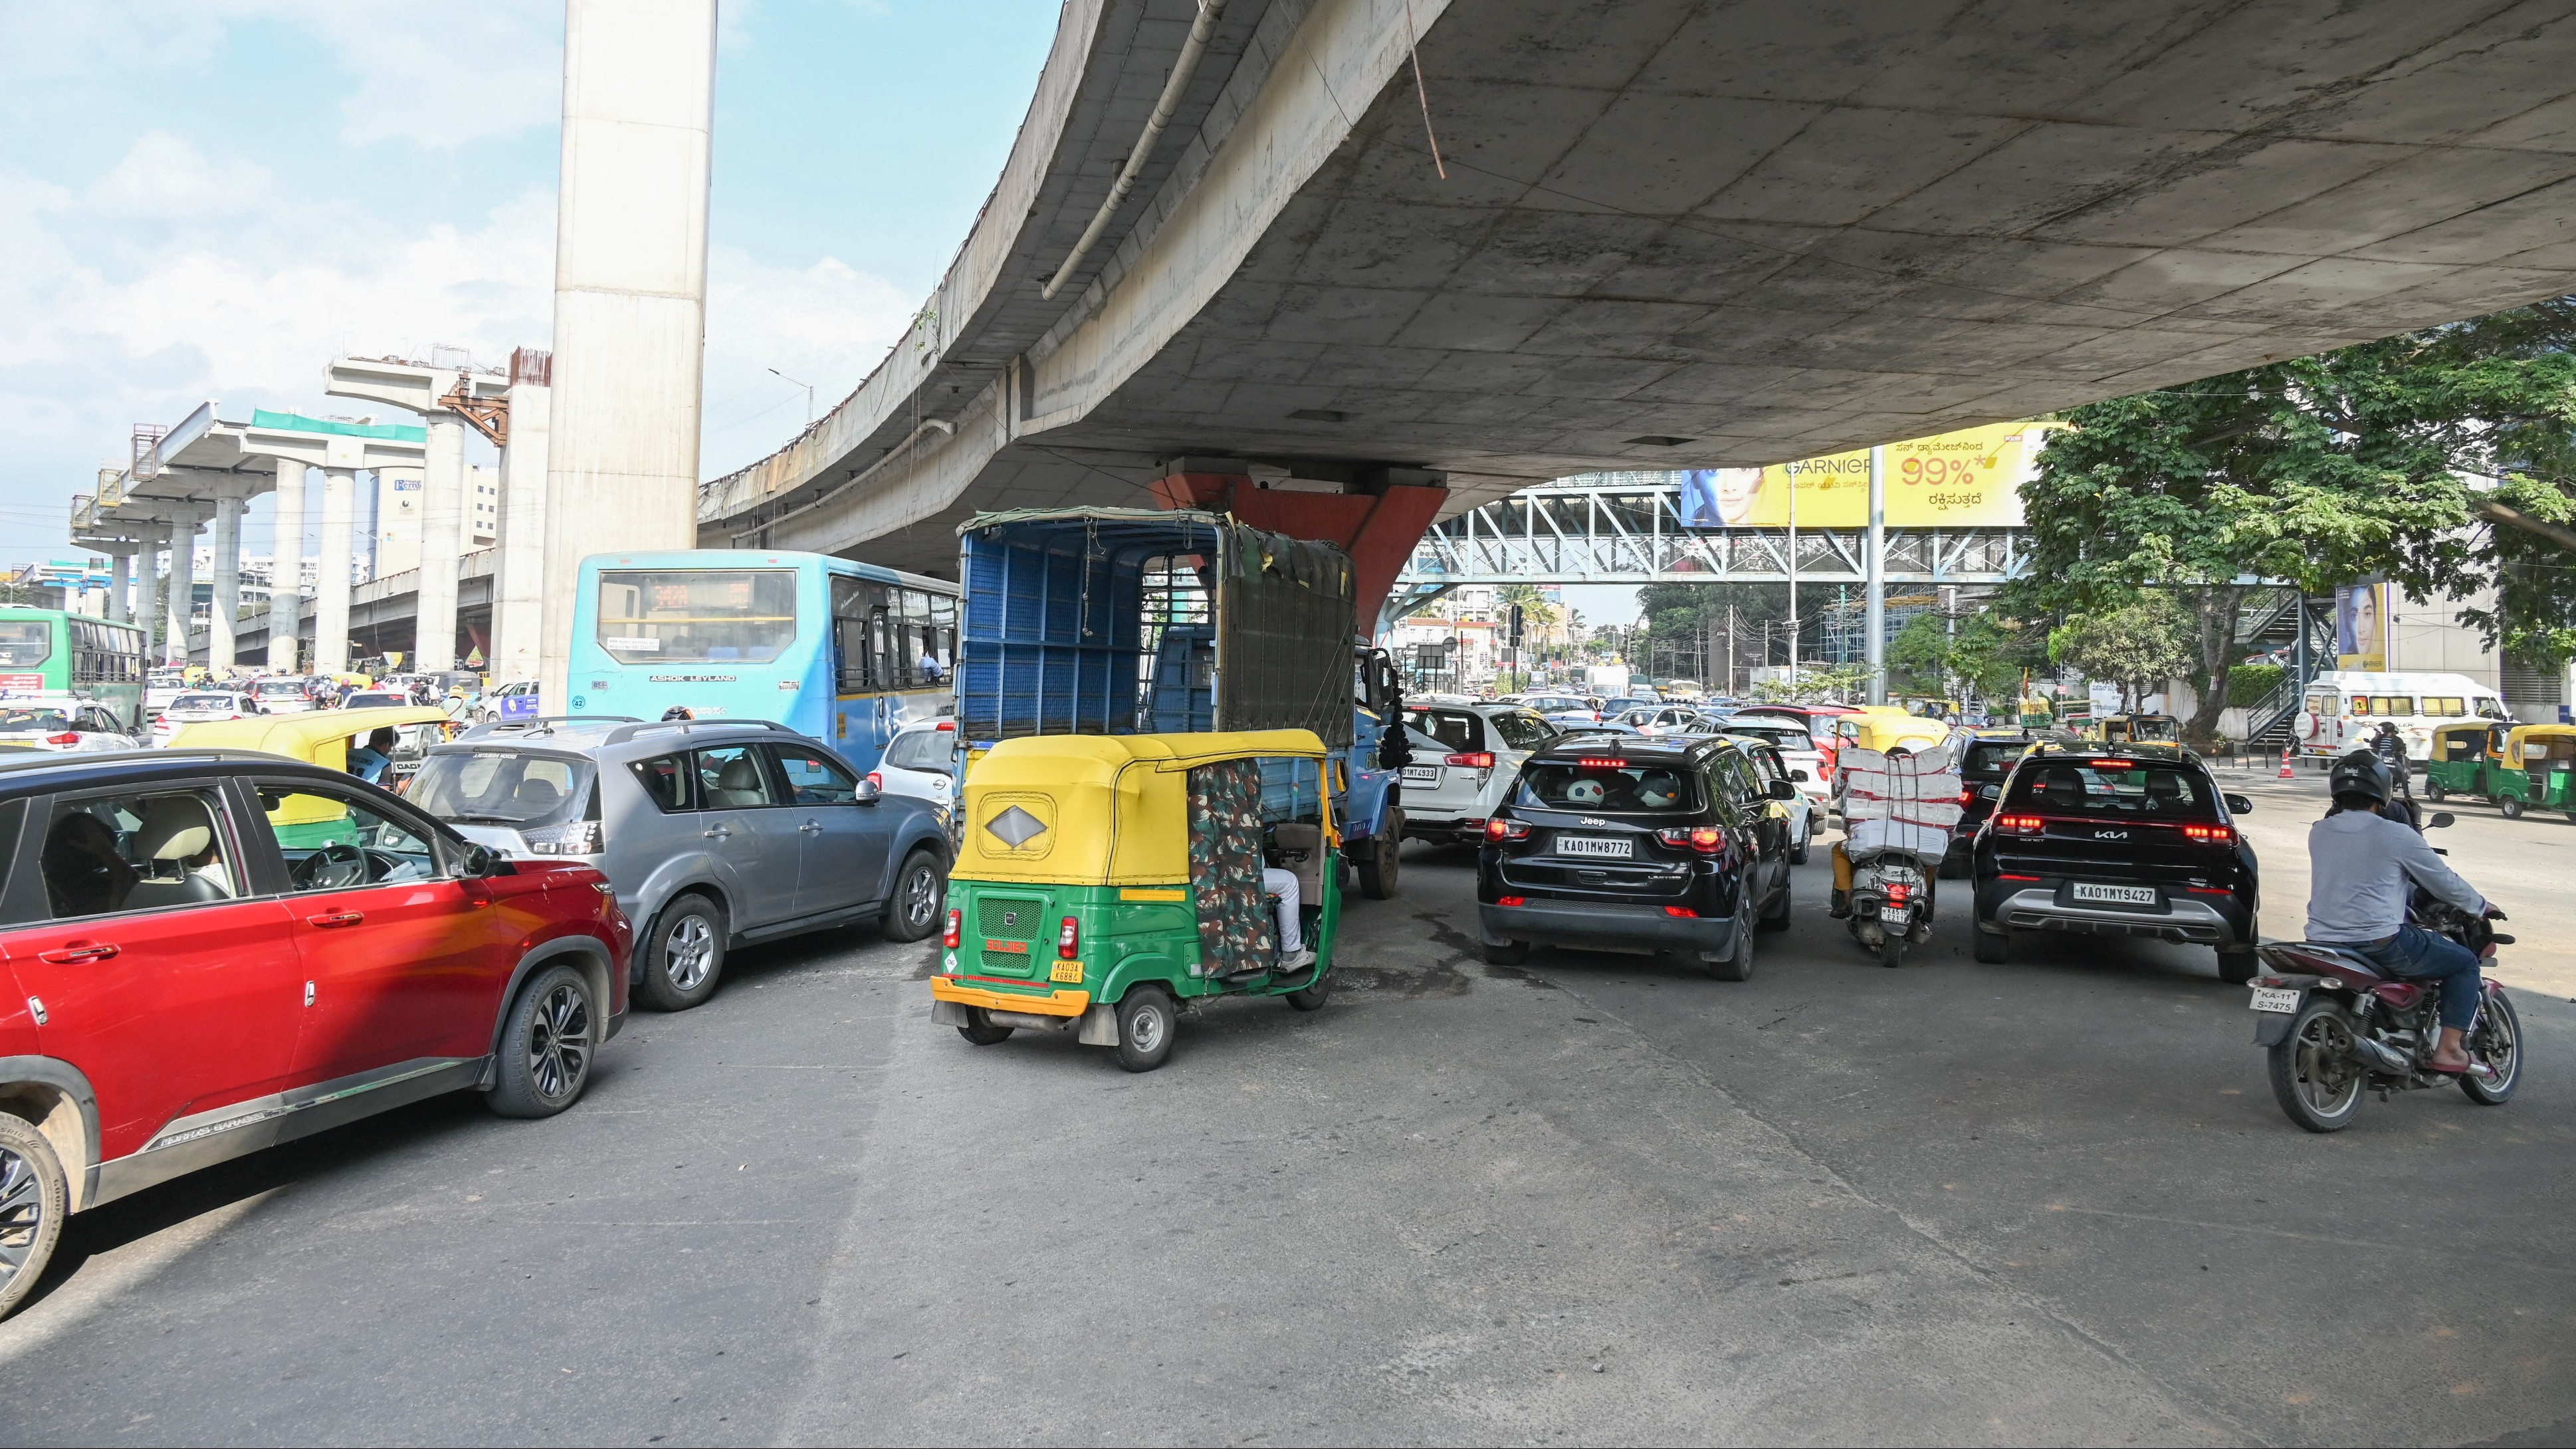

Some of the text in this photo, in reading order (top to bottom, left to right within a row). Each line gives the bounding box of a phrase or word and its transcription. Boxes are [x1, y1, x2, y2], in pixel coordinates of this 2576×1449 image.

[1896, 442, 1913, 452] ಸನ್
[1402, 768, 1434, 778] 01MT4933
[1580, 816, 1606, 827] Jeep
[1564, 839, 1630, 854] KA01MW8772
[2080, 886, 2153, 902] KA01MY9427
[1056, 962, 1079, 972] KA03A
[1055, 972, 1078, 982] K6884
[2261, 992, 2291, 1000] KA-11
[2257, 1001, 2292, 1011] S-7475
[213, 1111, 265, 1132] GARAGES
